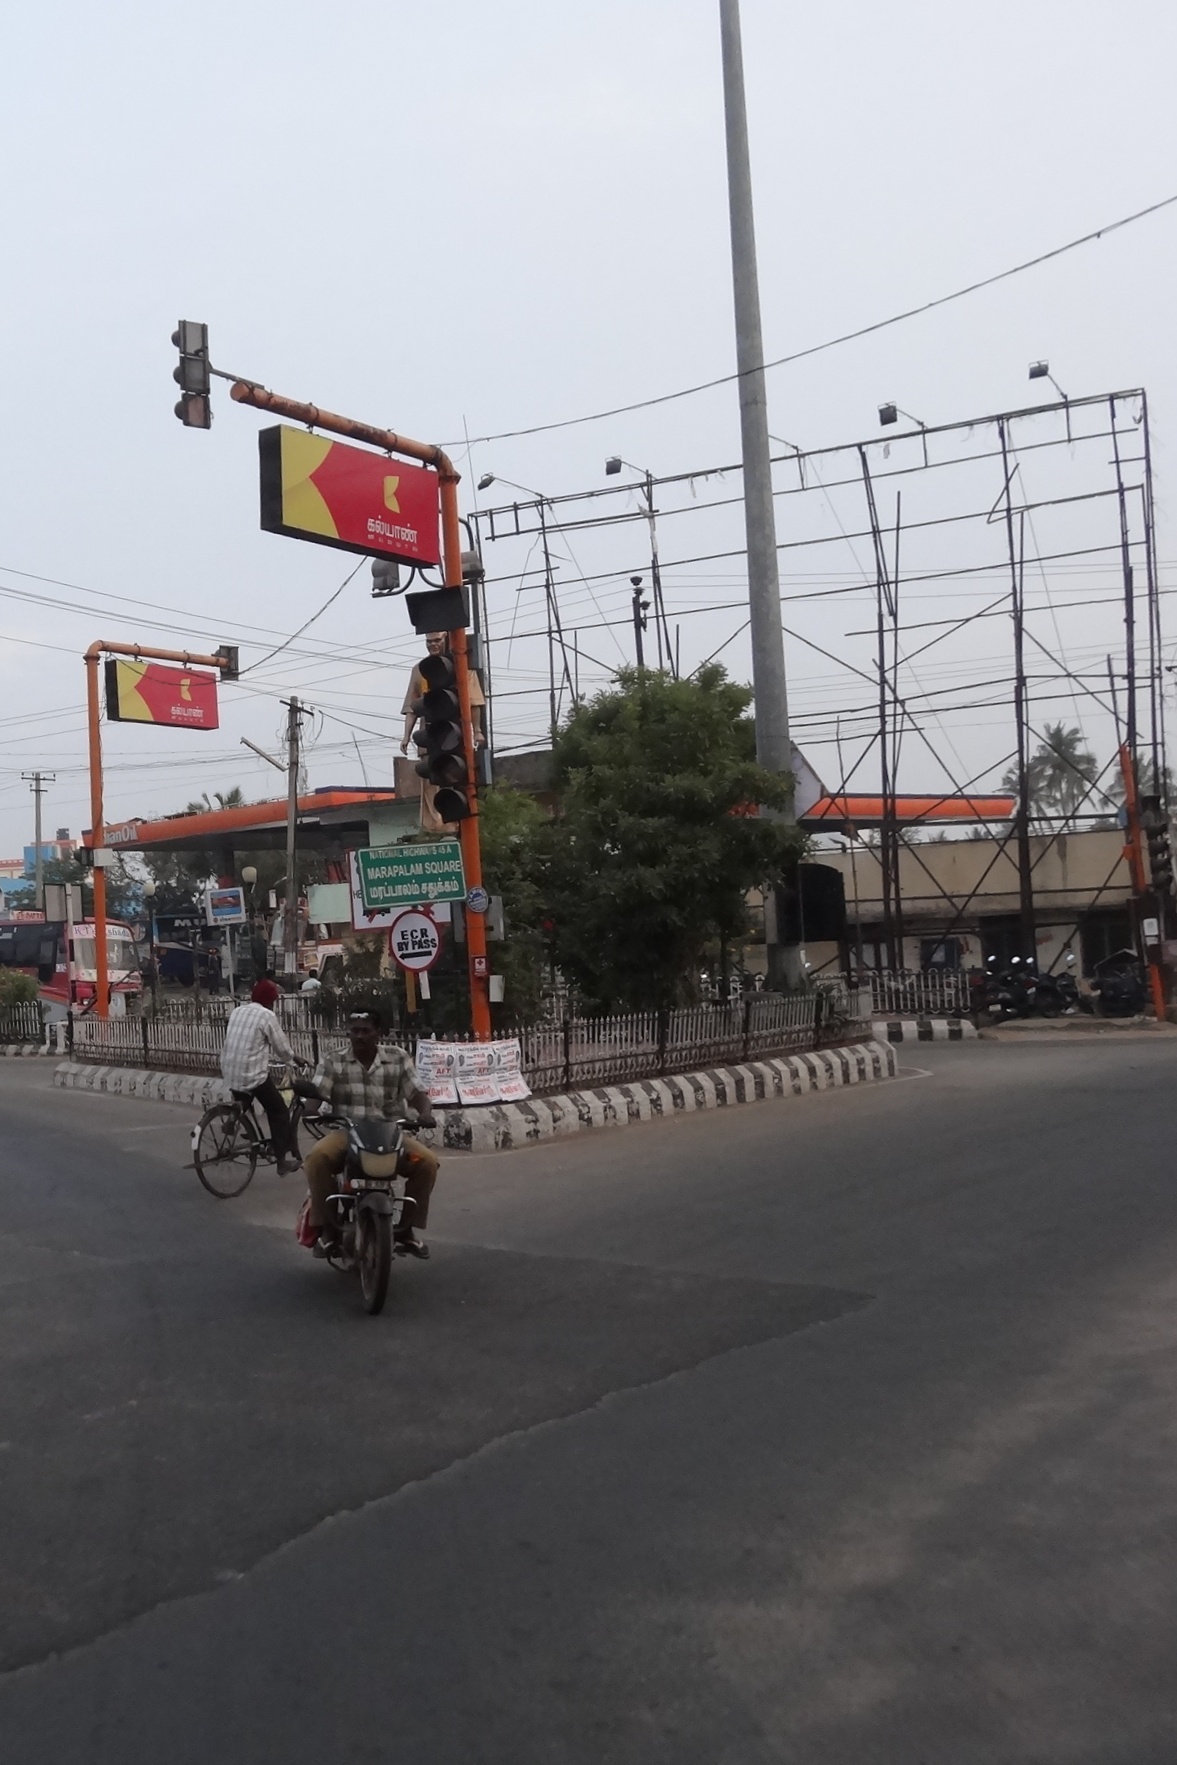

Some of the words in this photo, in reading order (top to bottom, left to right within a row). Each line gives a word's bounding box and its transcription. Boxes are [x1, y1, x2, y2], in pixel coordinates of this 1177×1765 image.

[367, 514, 417, 543] கல்யாண்
[369, 849, 403, 860] NATIONAL
[367, 863, 423, 879] MARAPALAM
[424, 860, 461, 874] SQUARE
[400, 928, 428, 940] ECR
[397, 940, 409, 952] BY
[411, 938, 437, 951] PASS
